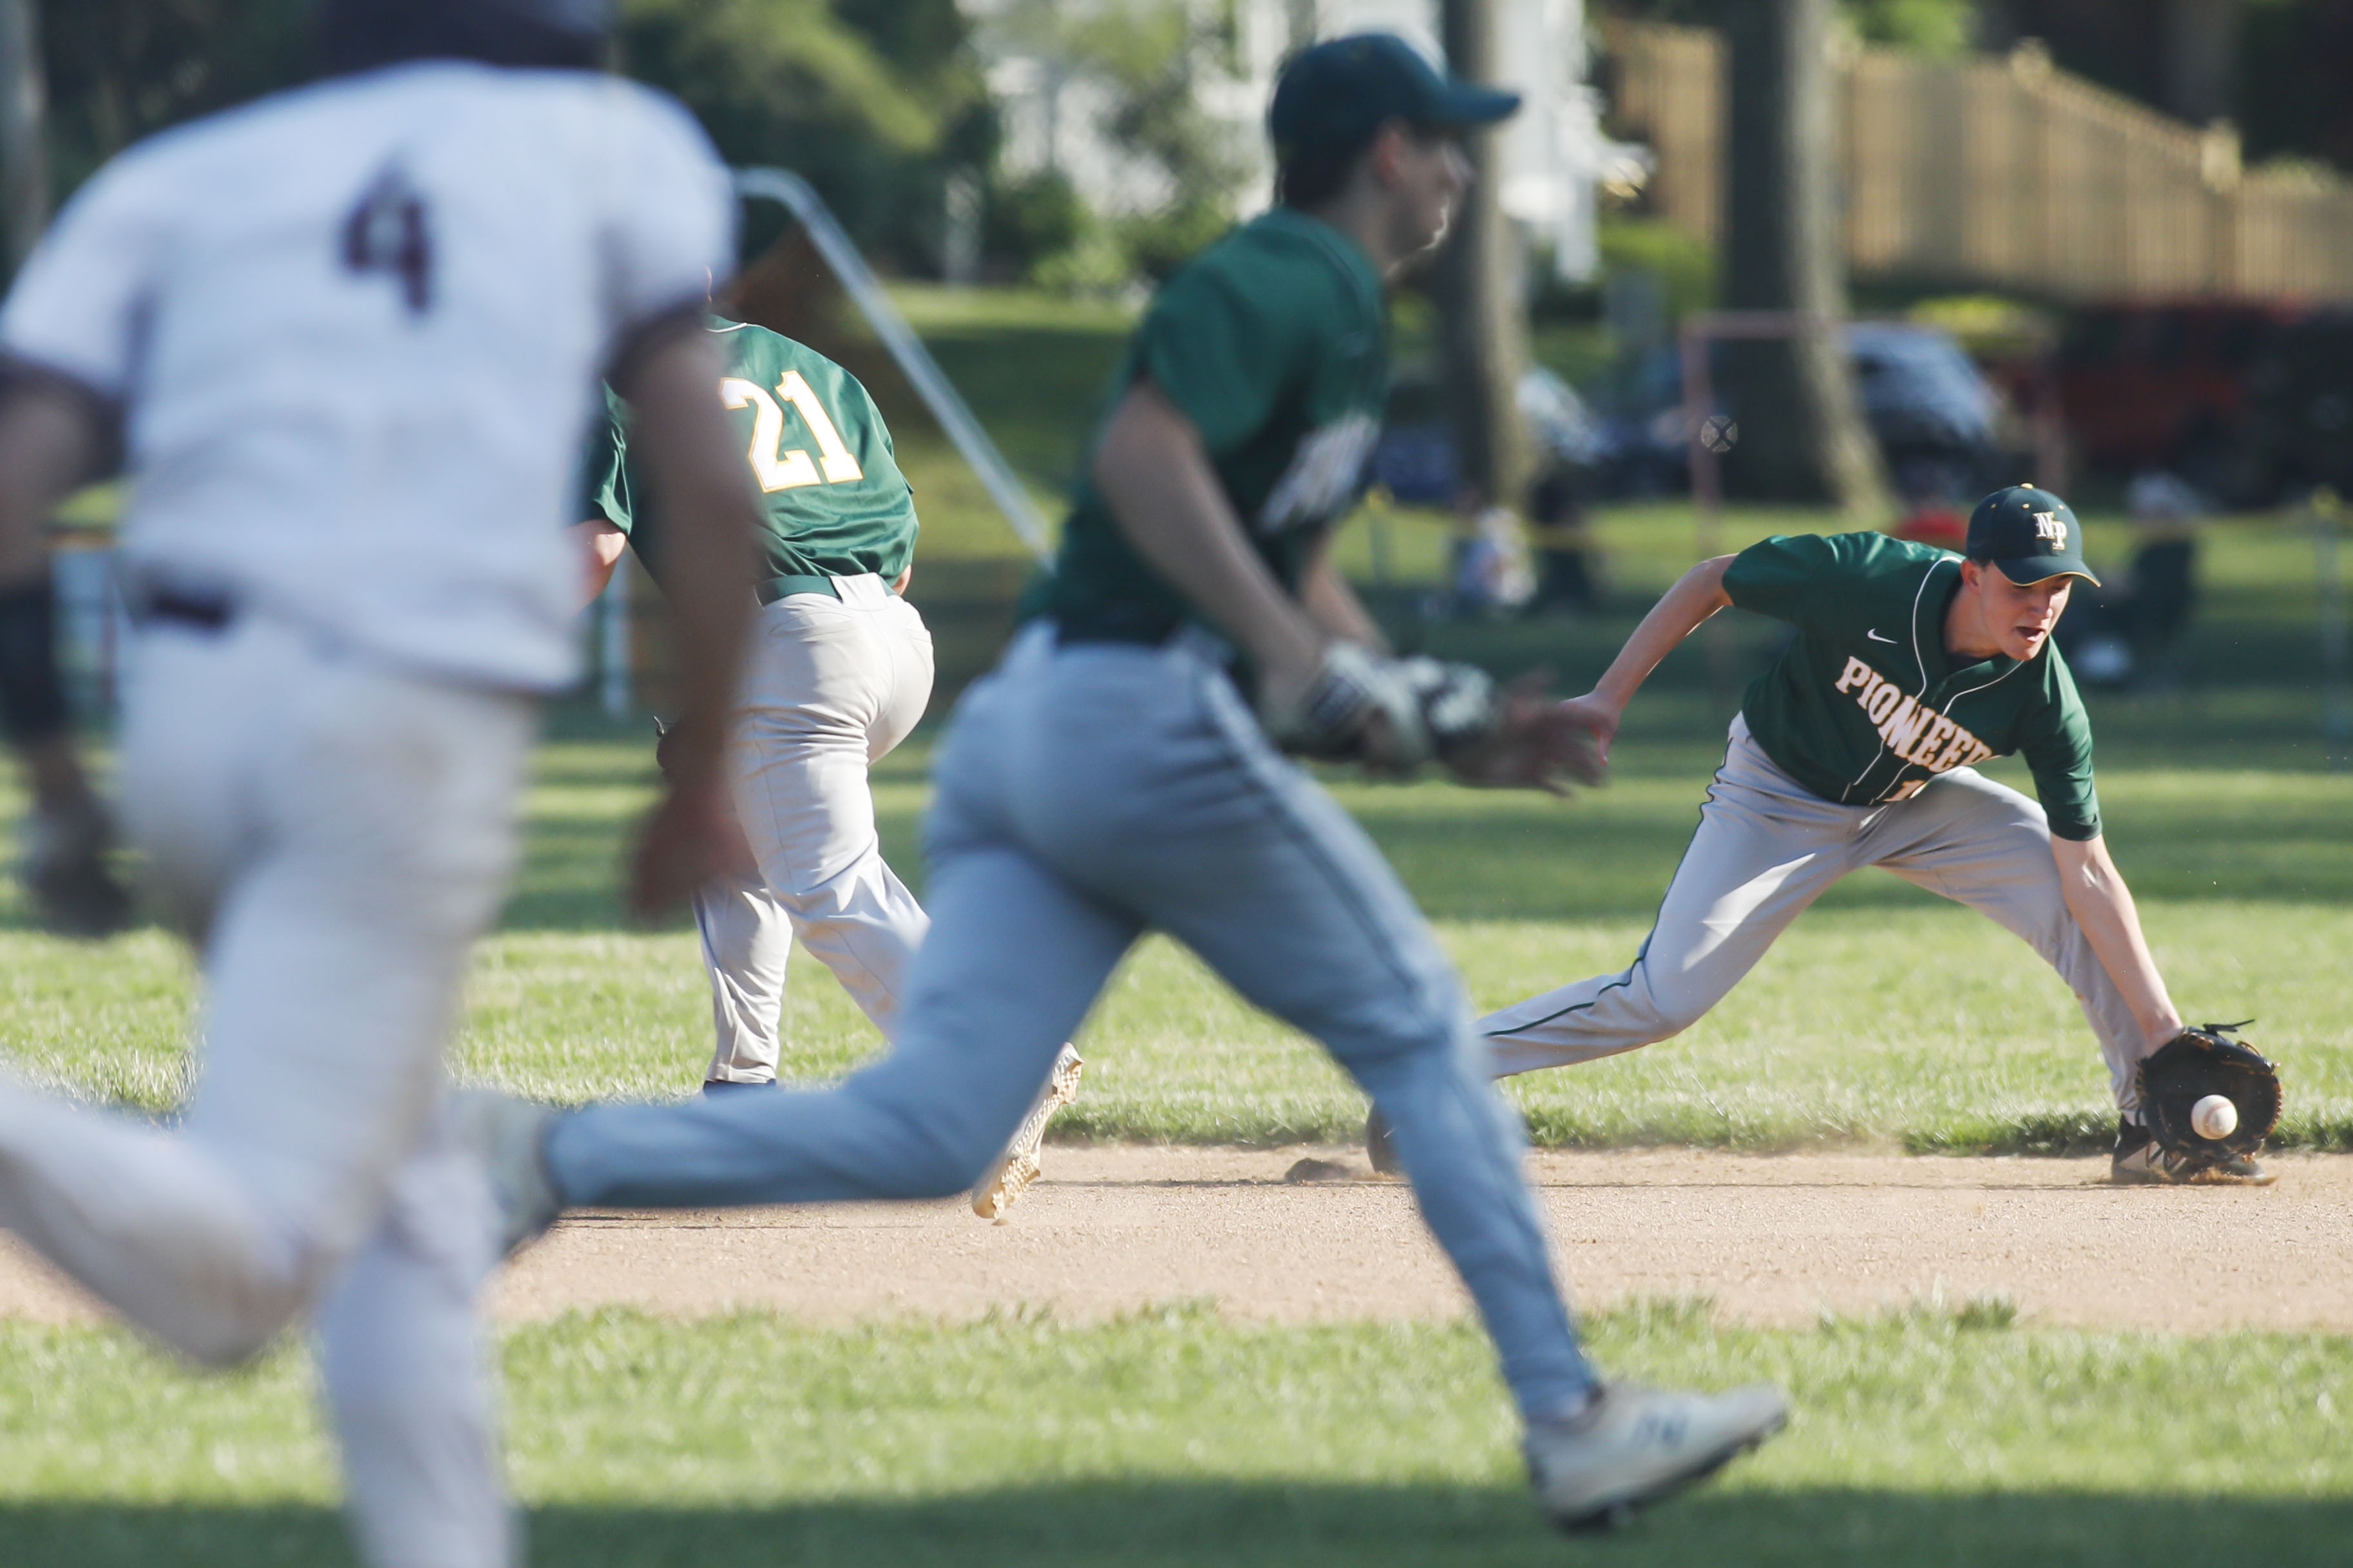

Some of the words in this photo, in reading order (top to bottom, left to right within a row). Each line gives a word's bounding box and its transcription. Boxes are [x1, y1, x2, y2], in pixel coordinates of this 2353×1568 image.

[335, 169, 435, 319] 4
[718, 369, 864, 494] 21
[2033, 511, 2068, 551] NP
